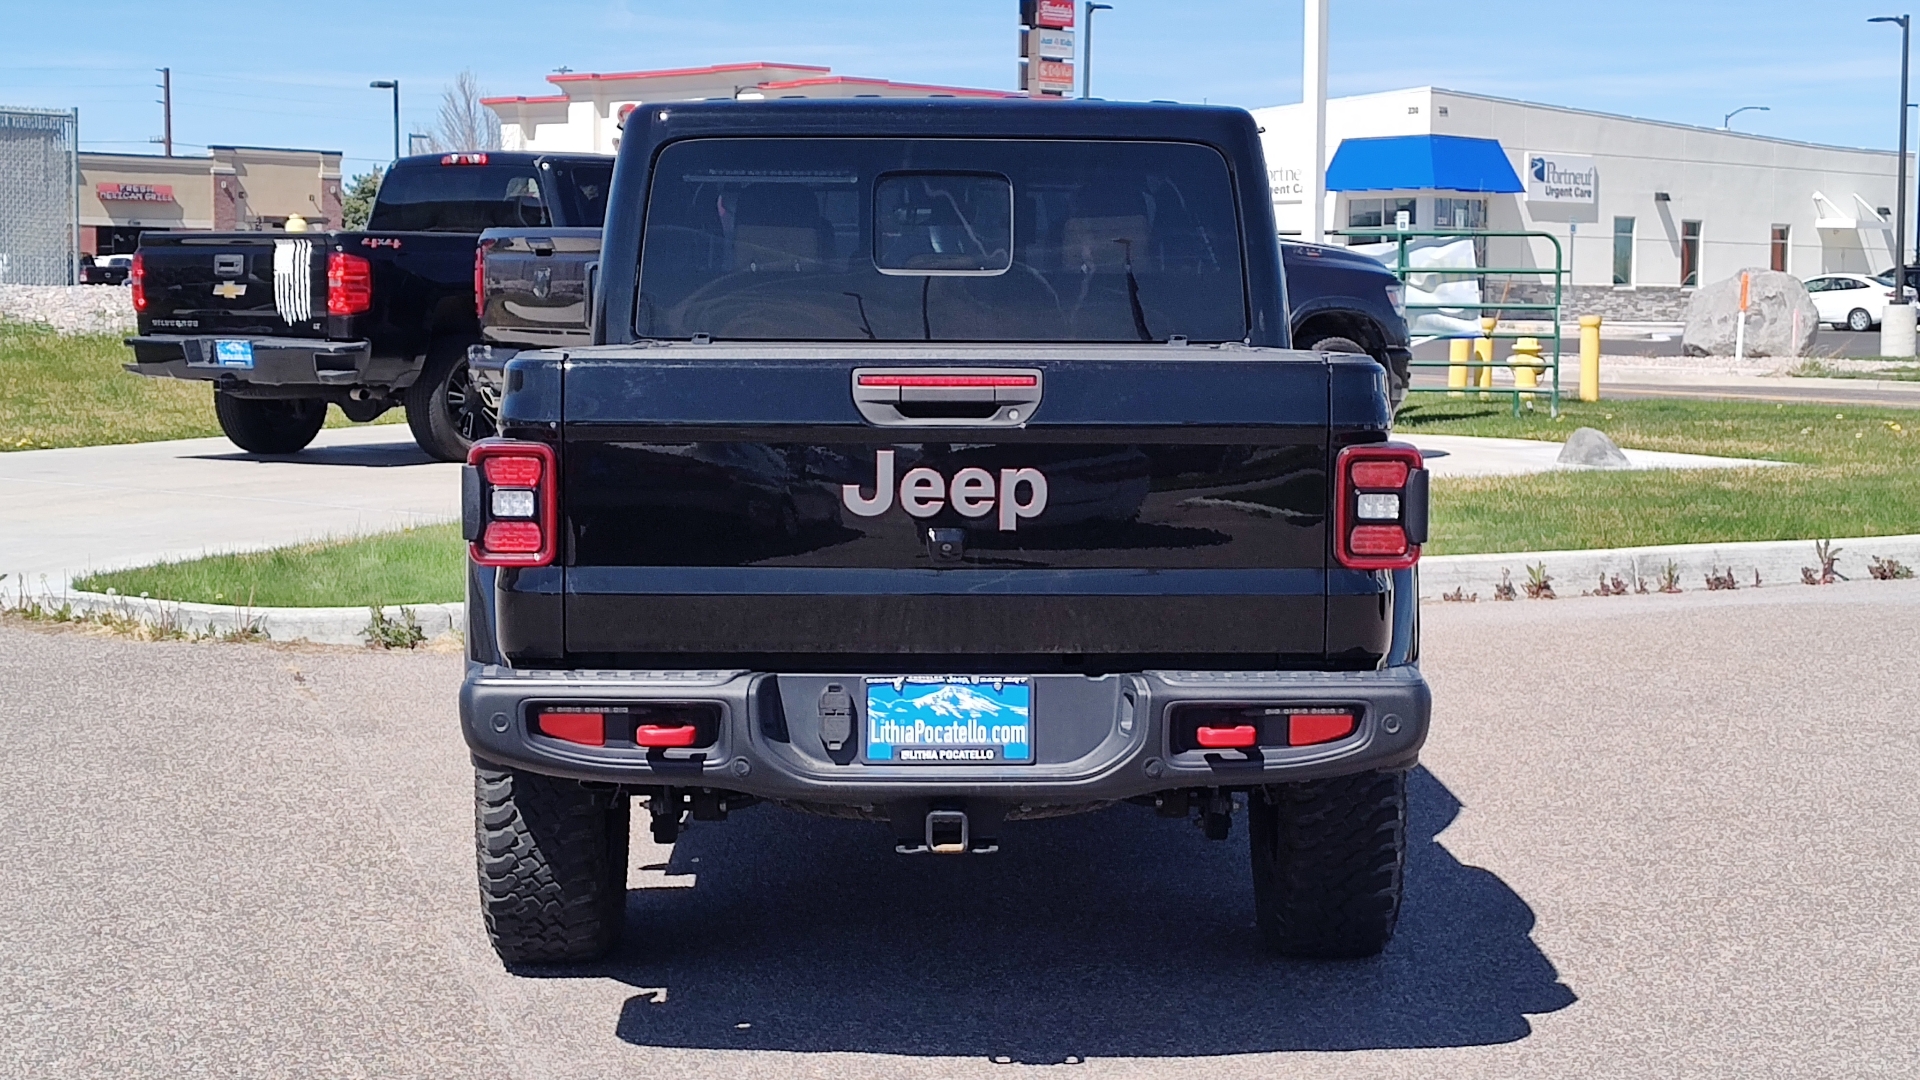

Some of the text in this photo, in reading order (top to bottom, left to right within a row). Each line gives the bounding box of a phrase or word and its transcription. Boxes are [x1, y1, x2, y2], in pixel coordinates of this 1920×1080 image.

[1545, 161, 1593, 186] Portneuf
[119, 184, 155, 193] FRESH
[1545, 186, 1592, 198] Urgent Care
[100, 191, 173, 202] MEXICAN GRILL
[151, 319, 199, 328] SILVERADO
[842, 449, 1049, 531] Jeep
[870, 719, 1026, 744] LithiaPocatello.com
[910, 749, 995, 760] LITHIA POCATELLO
